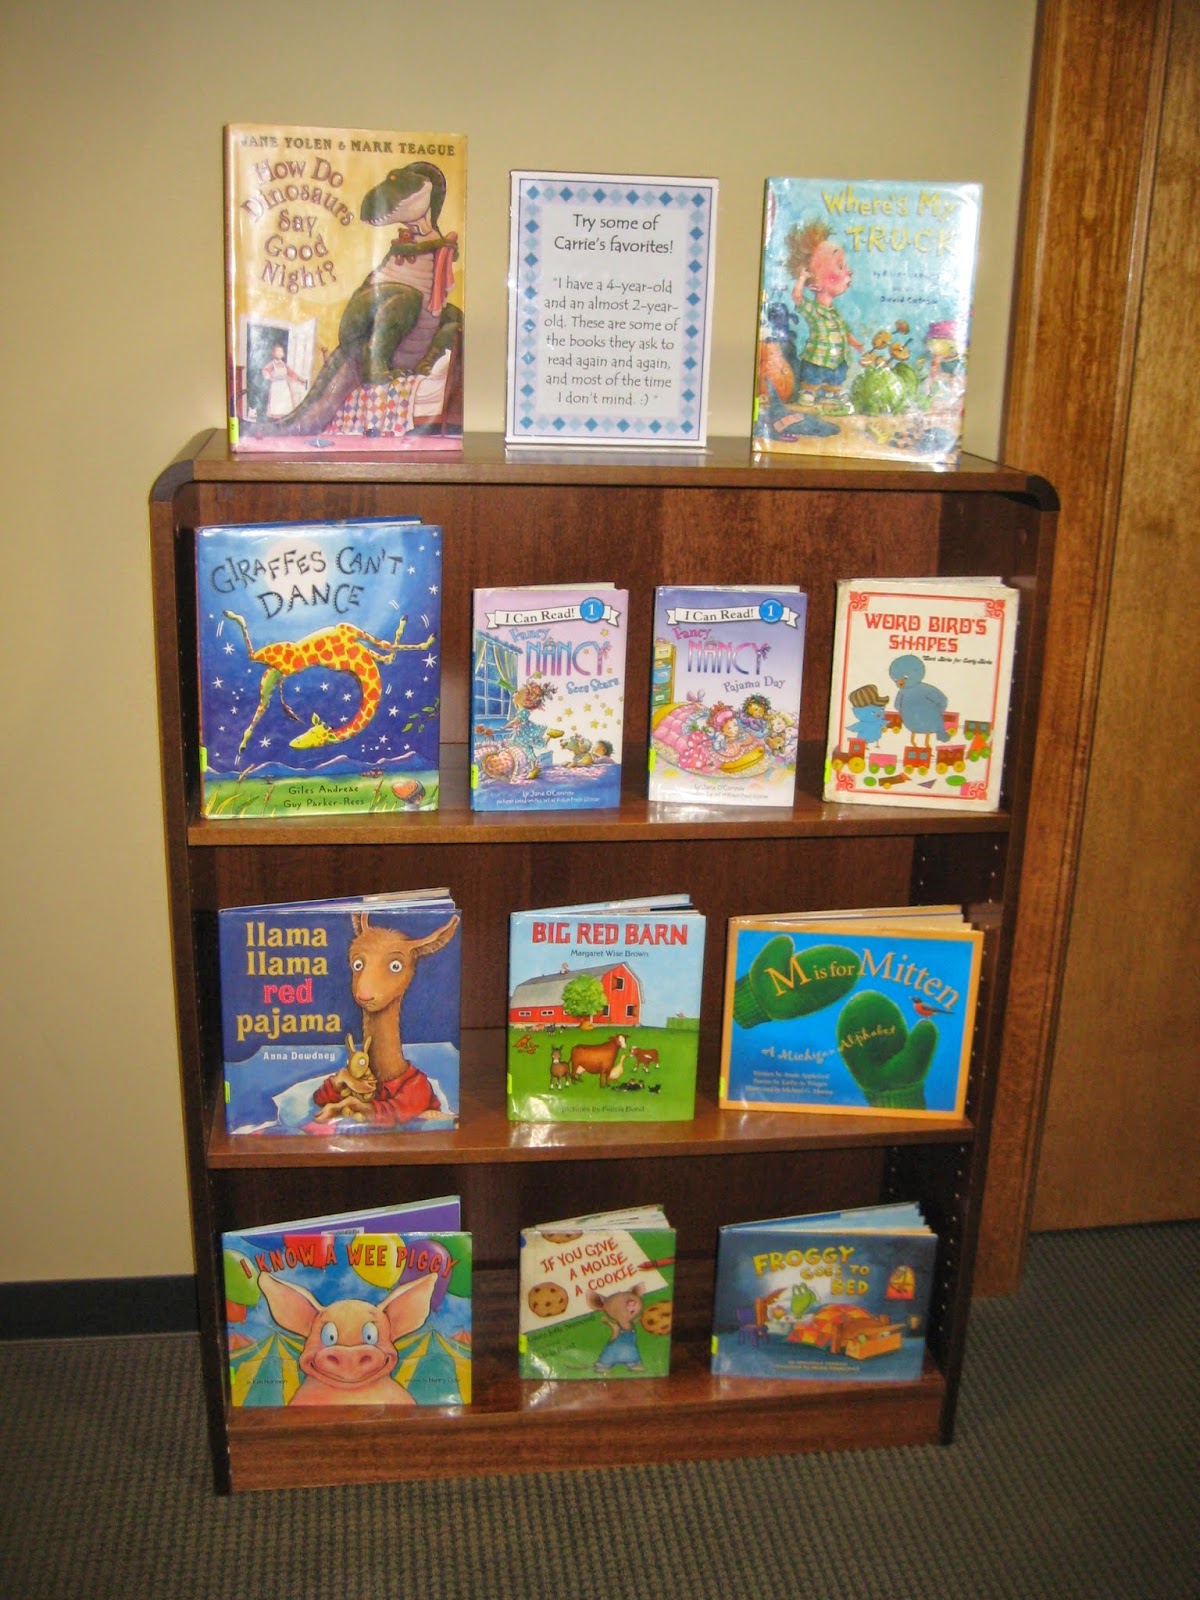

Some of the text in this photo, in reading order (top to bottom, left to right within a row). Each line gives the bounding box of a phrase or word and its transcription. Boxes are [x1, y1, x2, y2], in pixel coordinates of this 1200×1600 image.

[240, 136, 455, 156] JANE YOLEN & MARK TEAGUE
[254, 157, 344, 188] How Do
[241, 184, 354, 226] Dinosaurs
[821, 184, 960, 221] Where's My
[278, 209, 317, 236] Say
[573, 214, 661, 232] Try some of
[264, 234, 327, 261] Good
[554, 235, 673, 254] Carrie's favorites!
[262, 260, 336, 294] Night?
[566, 276, 593, 290] have
[597, 282, 602, 290] a
[606, 279, 672, 298] 4-year-old
[544, 298, 678, 315] and an almost 2-year-
[544, 314, 680, 332] old. These are some of
[546, 333, 674, 352] the books they ask to
[548, 354, 670, 372] read again and again,
[546, 372, 672, 388] and most of the time
[558, 392, 561, 402] I
[565, 392, 597, 404] don't
[210, 546, 403, 594] GIRAFFES CAN'T
[257, 582, 364, 619] DANCE
[504, 604, 595, 624] I Can Read! 1
[684, 604, 773, 621] I Can Read! 1
[509, 627, 550, 643] Fancy
[672, 626, 711, 641] Fancy
[865, 613, 987, 636] WORD BIRD'S
[888, 634, 959, 653] SHAPES
[526, 640, 611, 676] NANCY
[688, 640, 770, 675] NANCY
[723, 676, 786, 693] Pajama Day
[288, 784, 358, 794] Giles Andreae
[284, 797, 364, 810] Guy Parker-Rees
[245, 922, 327, 947] llama
[532, 922, 688, 946] BIG RED BARN
[247, 951, 328, 976] llama
[570, 950, 603, 959] Margaret
[764, 948, 960, 1009] M is for Mitten
[263, 978, 313, 1004] red
[236, 1007, 341, 1042] pajama
[263, 1051, 336, 1061] Anna Dewdney
[240, 1244, 459, 1279] I KNOW A WEE PIGGY
[540, 1237, 618, 1273] IF YOU GIVE
[569, 1252, 628, 1280] A MOUSE
[753, 1245, 855, 1277] FROGGY
[574, 1264, 638, 1296] A COOKIE
[800, 1265, 870, 1281] GOES TO
[830, 1279, 869, 1296] BED
